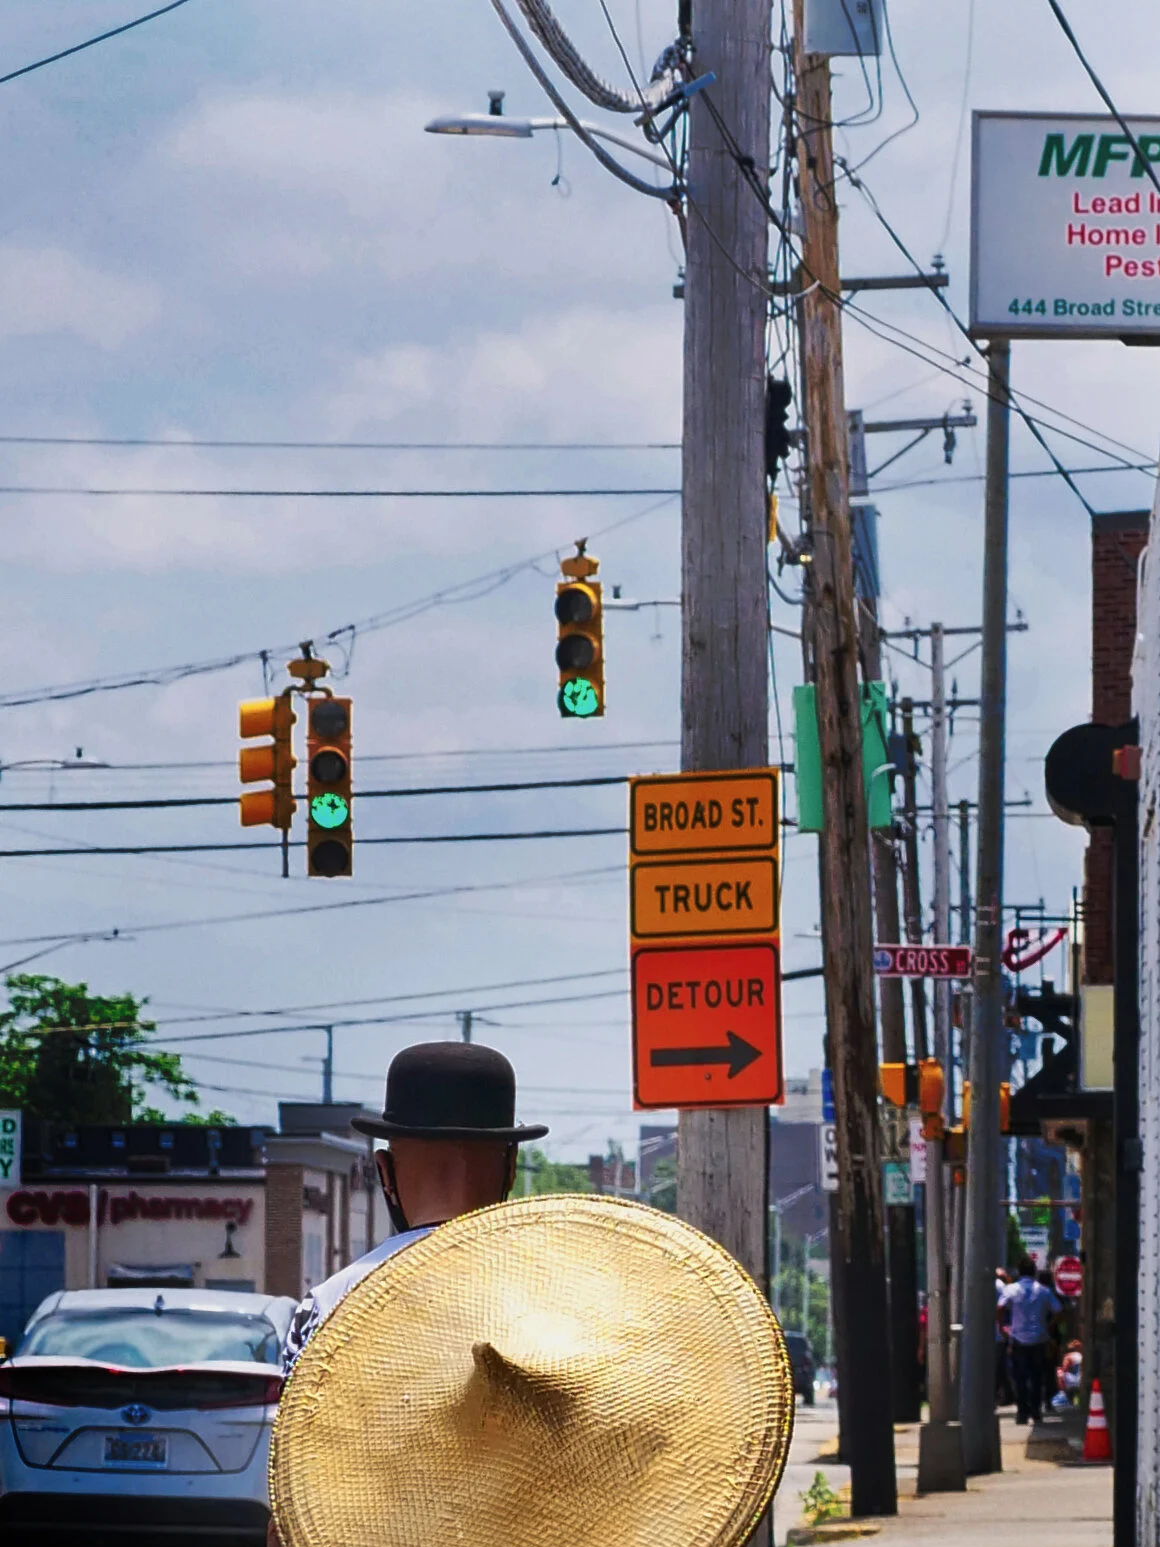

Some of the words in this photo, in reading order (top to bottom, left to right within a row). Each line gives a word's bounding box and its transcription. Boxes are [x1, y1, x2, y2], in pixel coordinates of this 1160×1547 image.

[1074, 191, 1140, 214] Lead
[1067, 223, 1146, 245] Home
[1008, 298, 1047, 316] 444
[1053, 298, 1115, 316] Broad
[644, 800, 722, 832] BROAD
[731, 796, 763, 828] ST.
[655, 880, 753, 914] TRUCK
[895, 949, 950, 972] CROSS
[646, 977, 765, 1011] DETOUR
